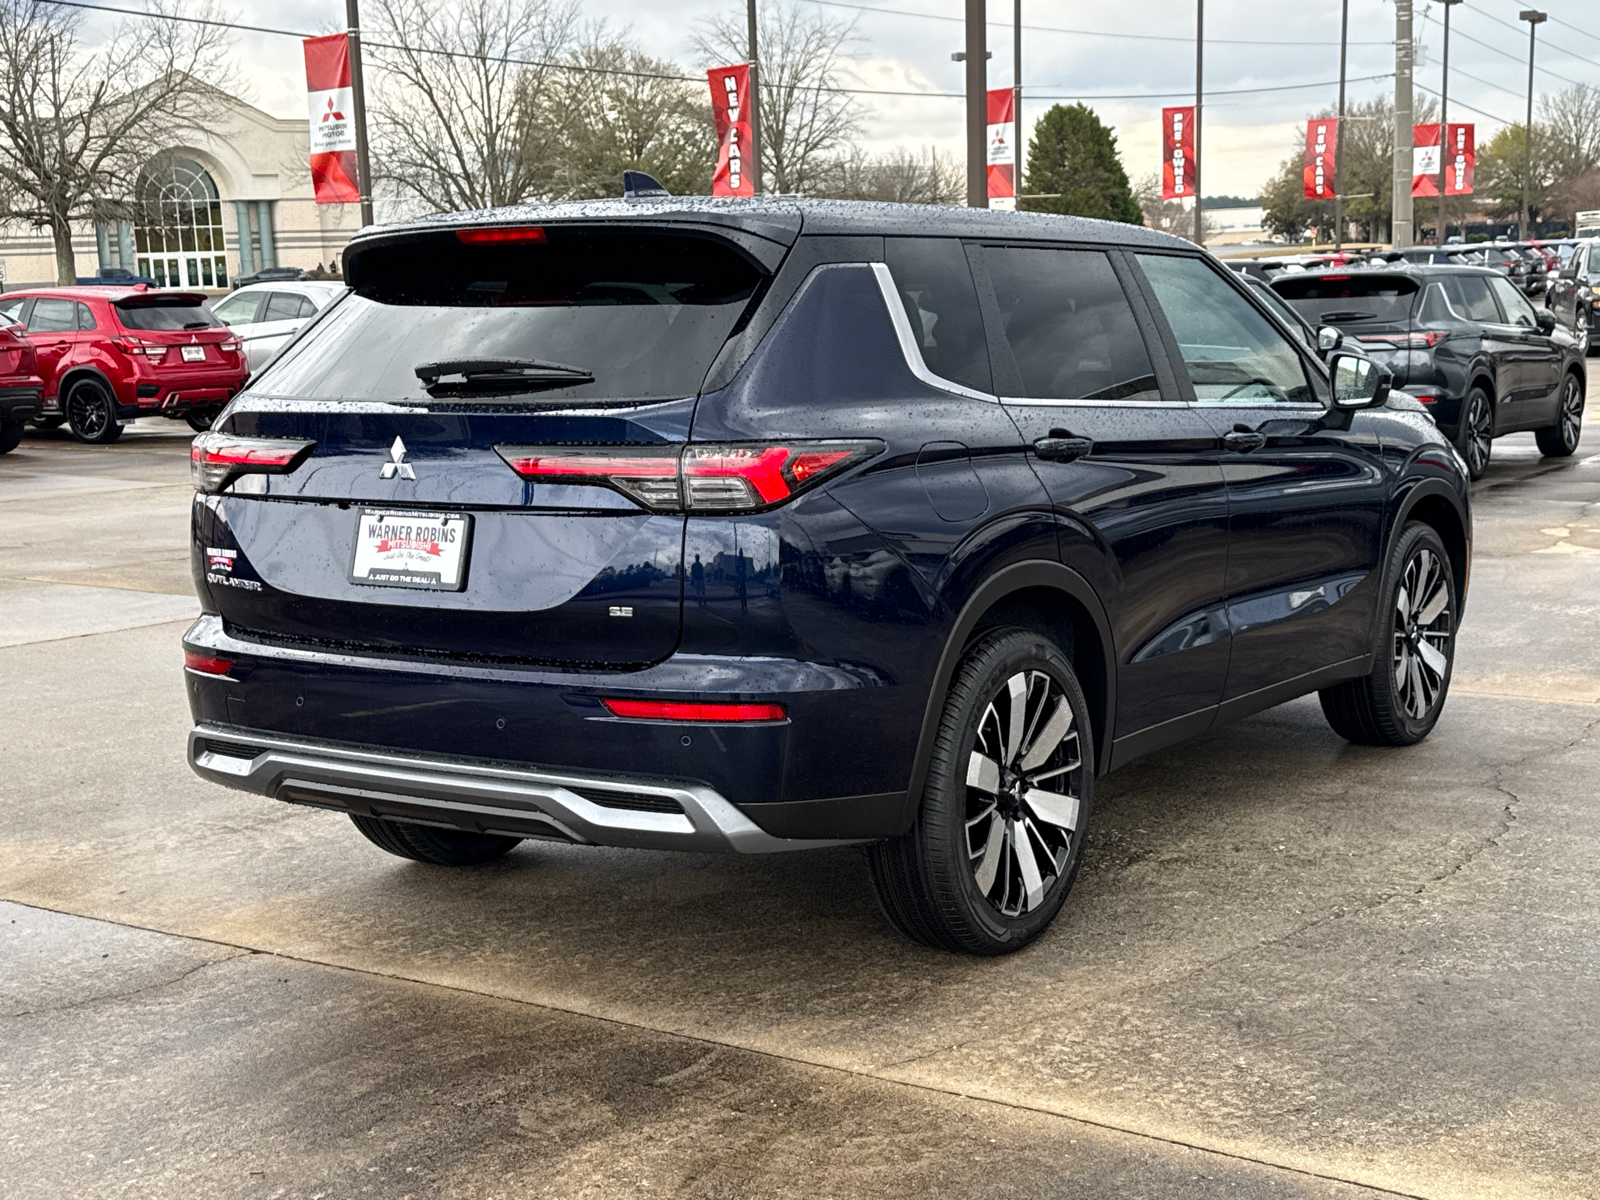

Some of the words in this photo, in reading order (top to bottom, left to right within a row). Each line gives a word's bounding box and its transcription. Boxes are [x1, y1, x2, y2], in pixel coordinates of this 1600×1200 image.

[724, 76, 740, 123] NEW
[728, 127, 741, 189] CARS
[368, 523, 412, 541] WARNER
[415, 526, 456, 543] ROBINS
[387, 539, 431, 552] MITSUBISHI
[608, 606, 633, 617] SE
